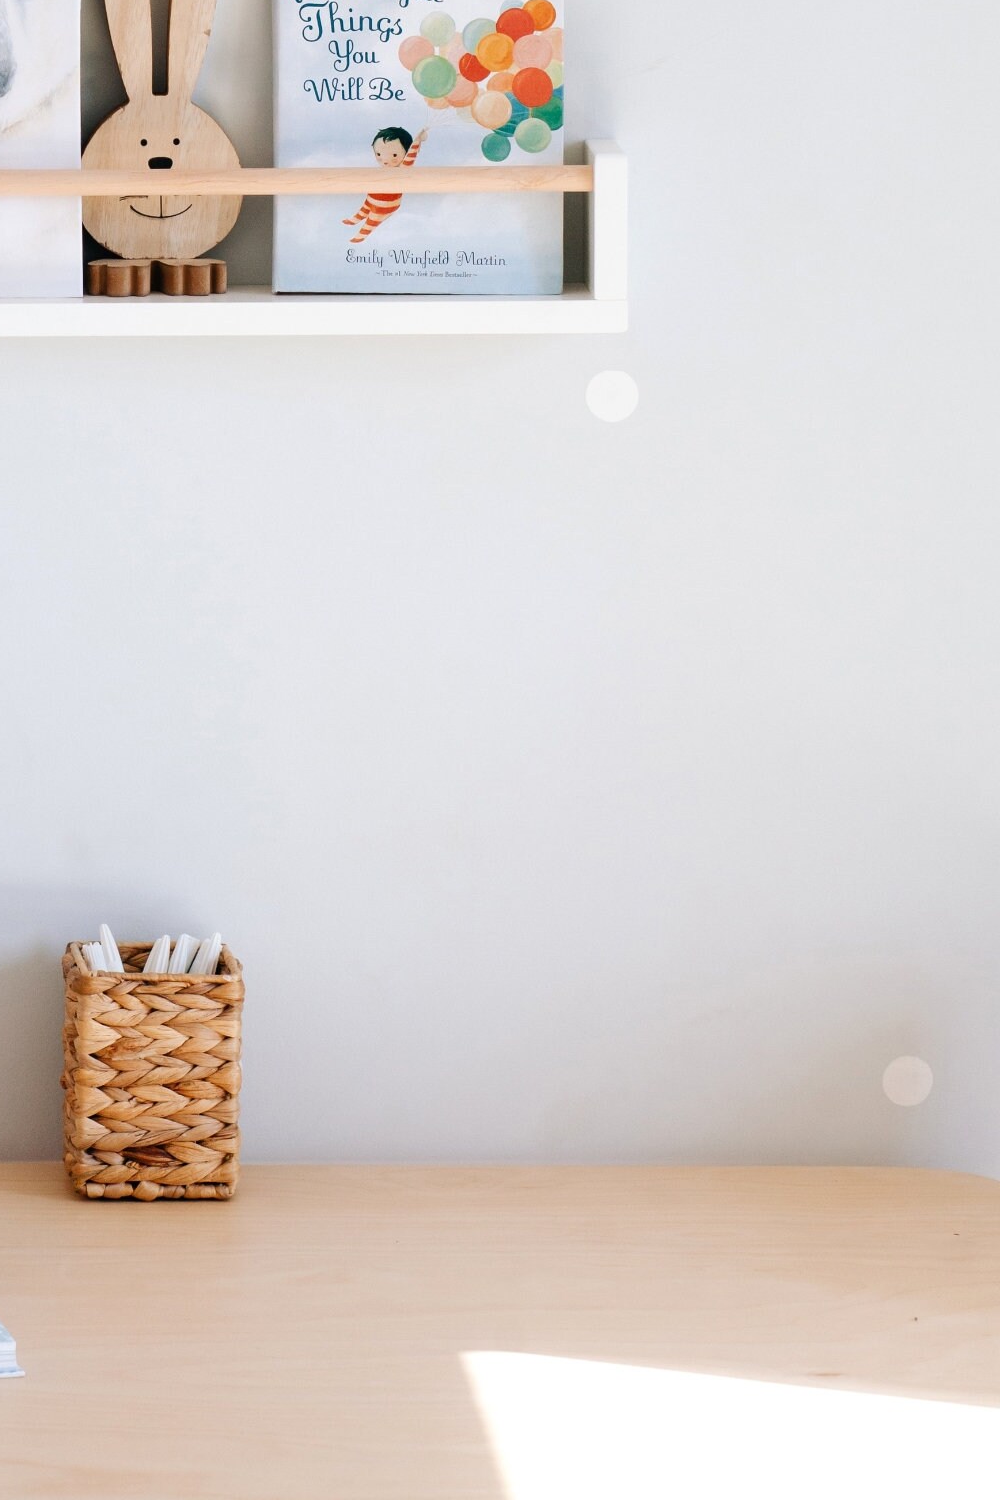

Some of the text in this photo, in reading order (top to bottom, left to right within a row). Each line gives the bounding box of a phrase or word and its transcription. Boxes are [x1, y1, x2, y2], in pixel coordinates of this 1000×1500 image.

[299, 0, 403, 43] Things
[328, 39, 380, 72] You
[303, 77, 406, 103] Will Be
[346, 248, 507, 269] Emily Winfield Martin
